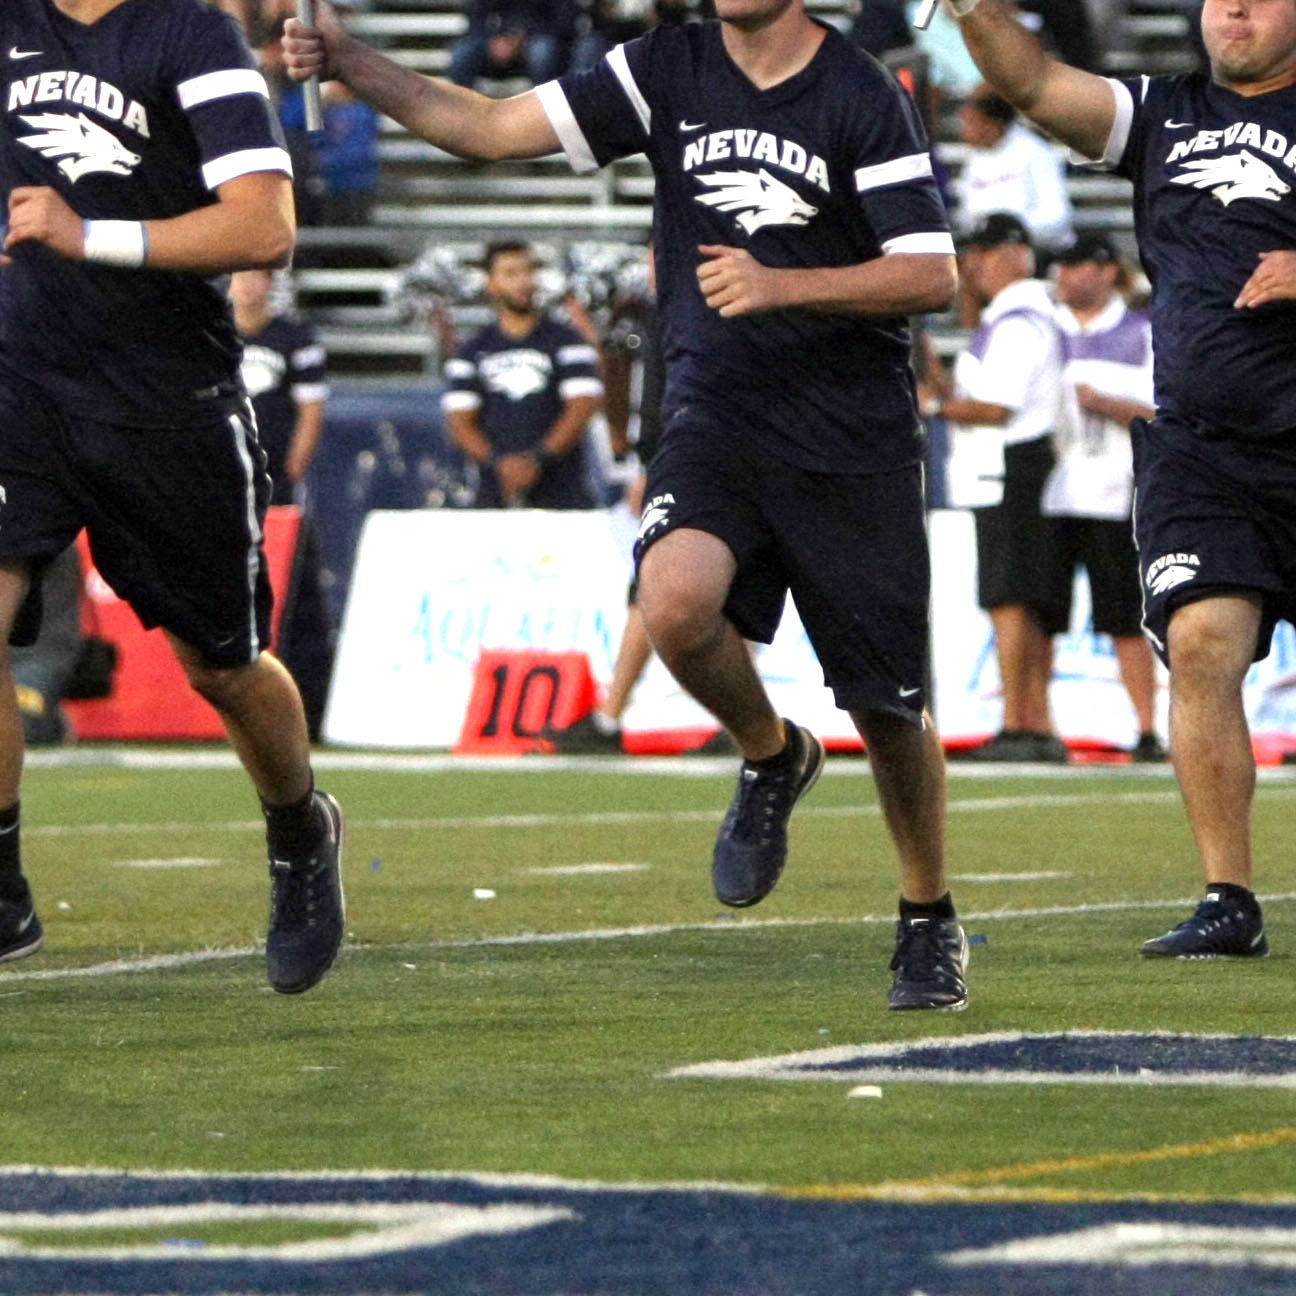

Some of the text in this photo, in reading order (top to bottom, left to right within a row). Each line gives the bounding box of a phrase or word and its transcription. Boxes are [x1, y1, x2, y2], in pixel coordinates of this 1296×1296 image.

[683, 128, 831, 193] NEVADA
[1145, 552, 1201, 589] NEVADA
[480, 664, 561, 737] 10
